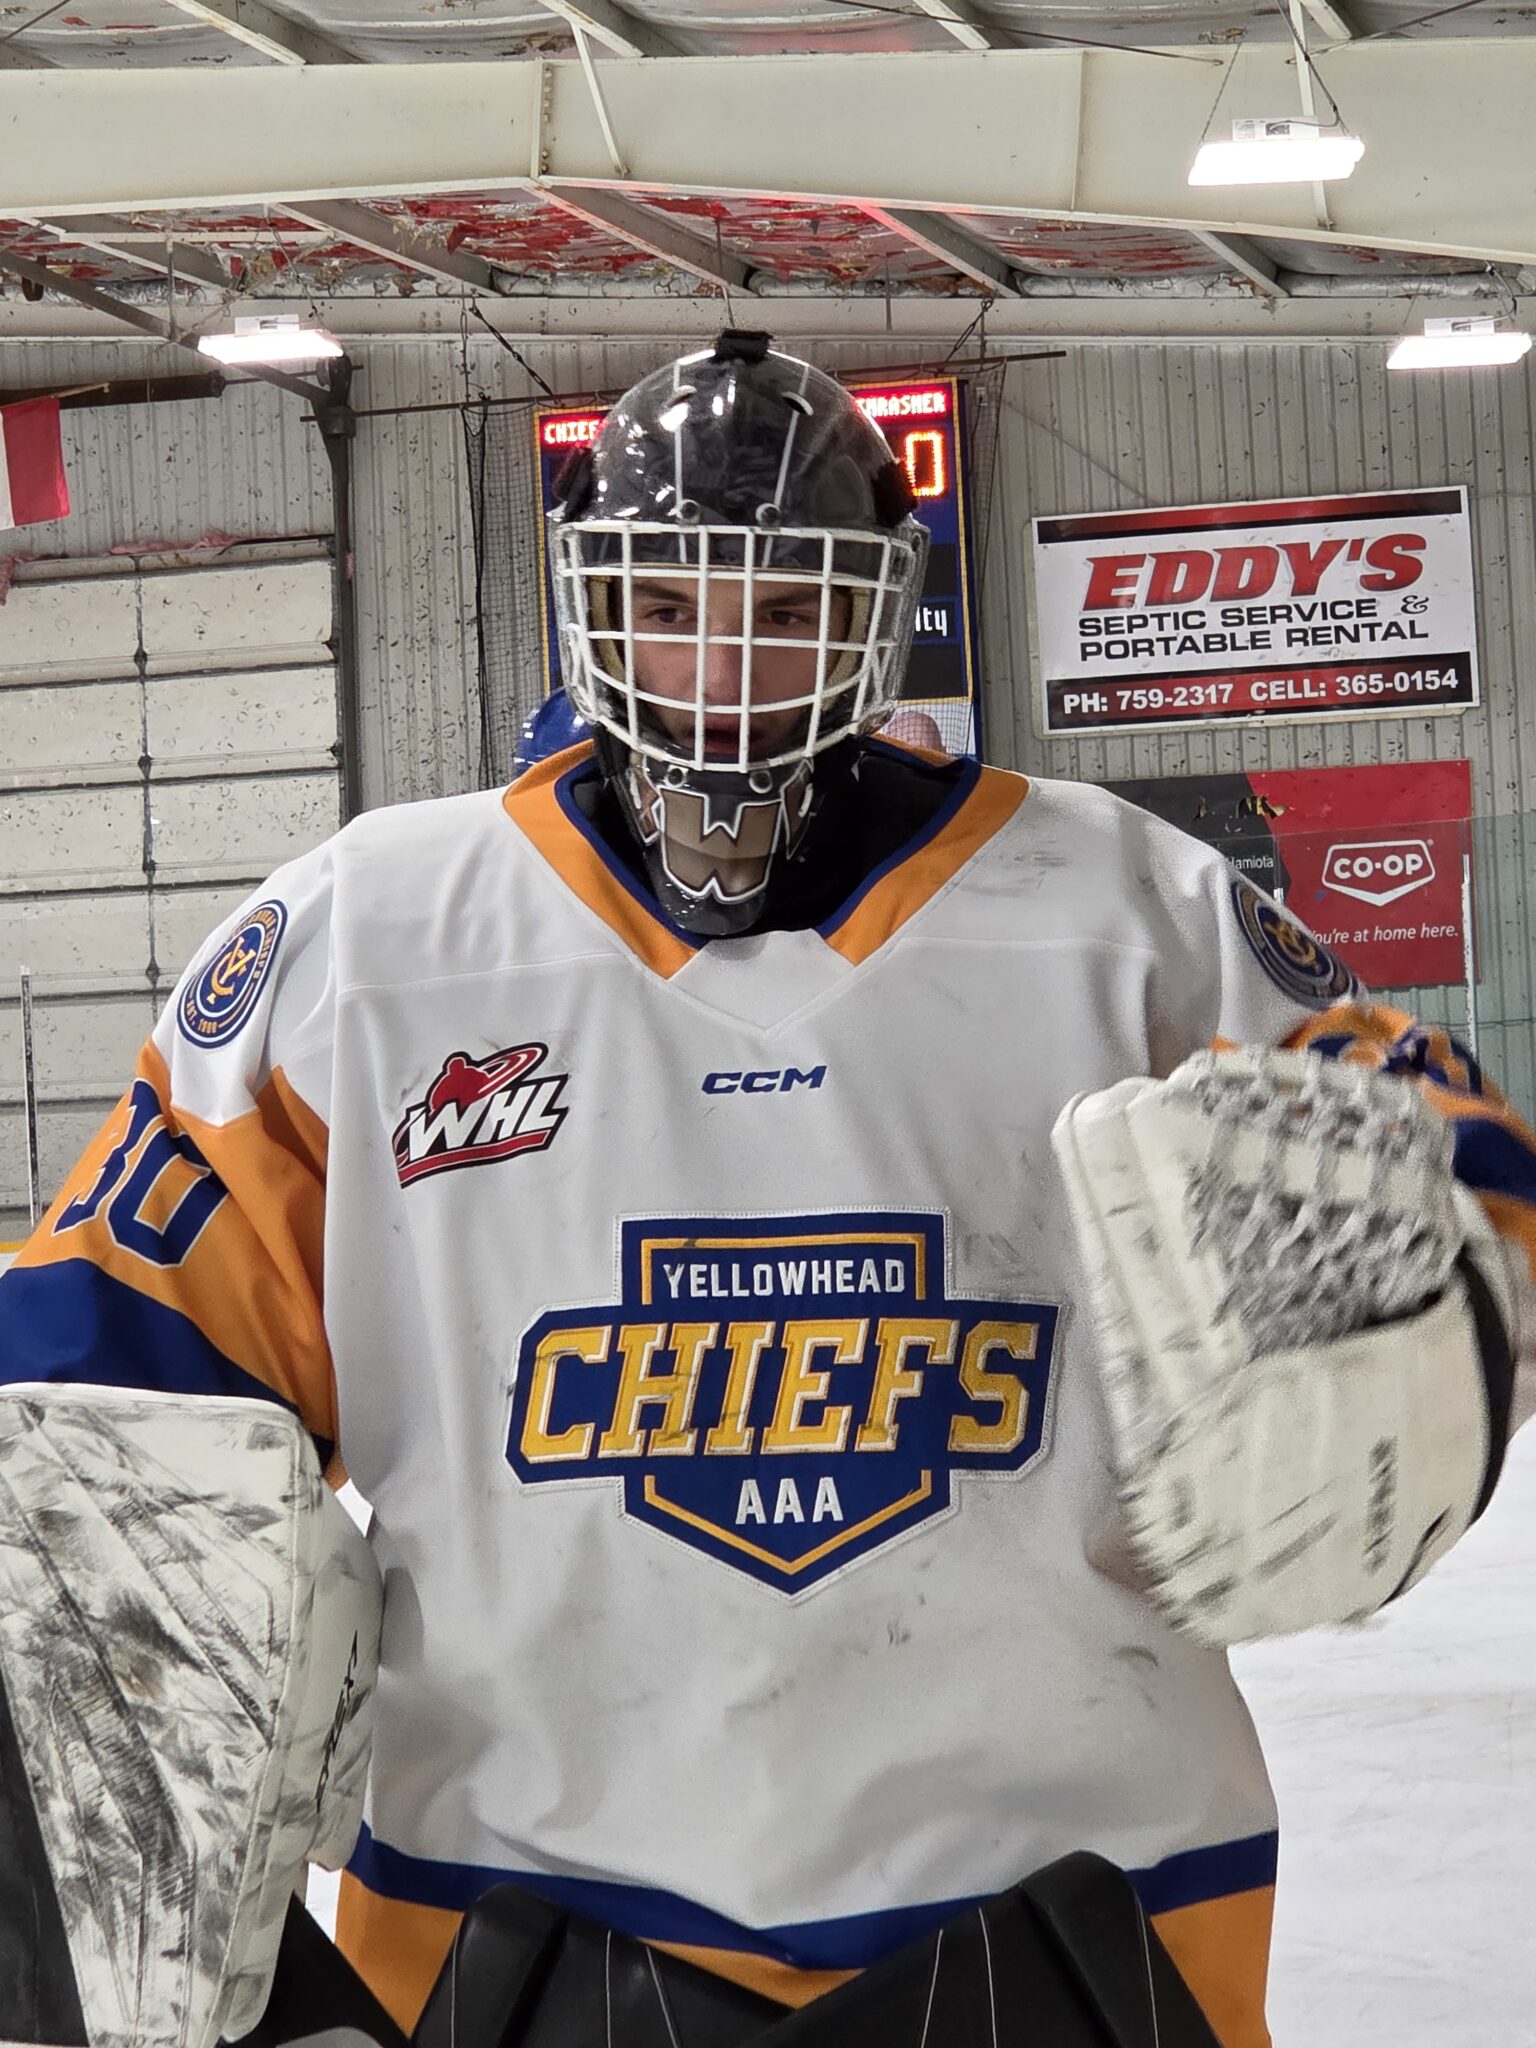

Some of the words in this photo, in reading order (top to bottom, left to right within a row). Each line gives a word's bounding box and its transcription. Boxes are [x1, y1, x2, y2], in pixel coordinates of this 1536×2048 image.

[545, 419, 602, 444] CHIEF
[905, 430, 945, 497] 0
[1082, 533, 1427, 611] EDDY'S
[1079, 610, 1207, 637] SEPTIC
[1220, 598, 1378, 628] SERVICE
[1400, 595, 1430, 615] &
[1080, 630, 1272, 662] PORTABLE
[1286, 620, 1429, 648] RENTAL
[1063, 692, 1108, 714] PH:
[1116, 683, 1234, 711] 759-2317
[1250, 678, 1327, 702] CELL:
[1335, 668, 1459, 697] 365-0154
[1353, 928, 1369, 943] at
[1373, 925, 1416, 941] home
[1420, 922, 1459, 938] here.
[701, 1065, 828, 1095] CCM
[408, 1078, 562, 1162] WHL
[662, 1258, 906, 1299] YELLOWHEAD
[520, 1318, 1040, 1464] CHIEFS
[735, 1477, 844, 1525] AAA
